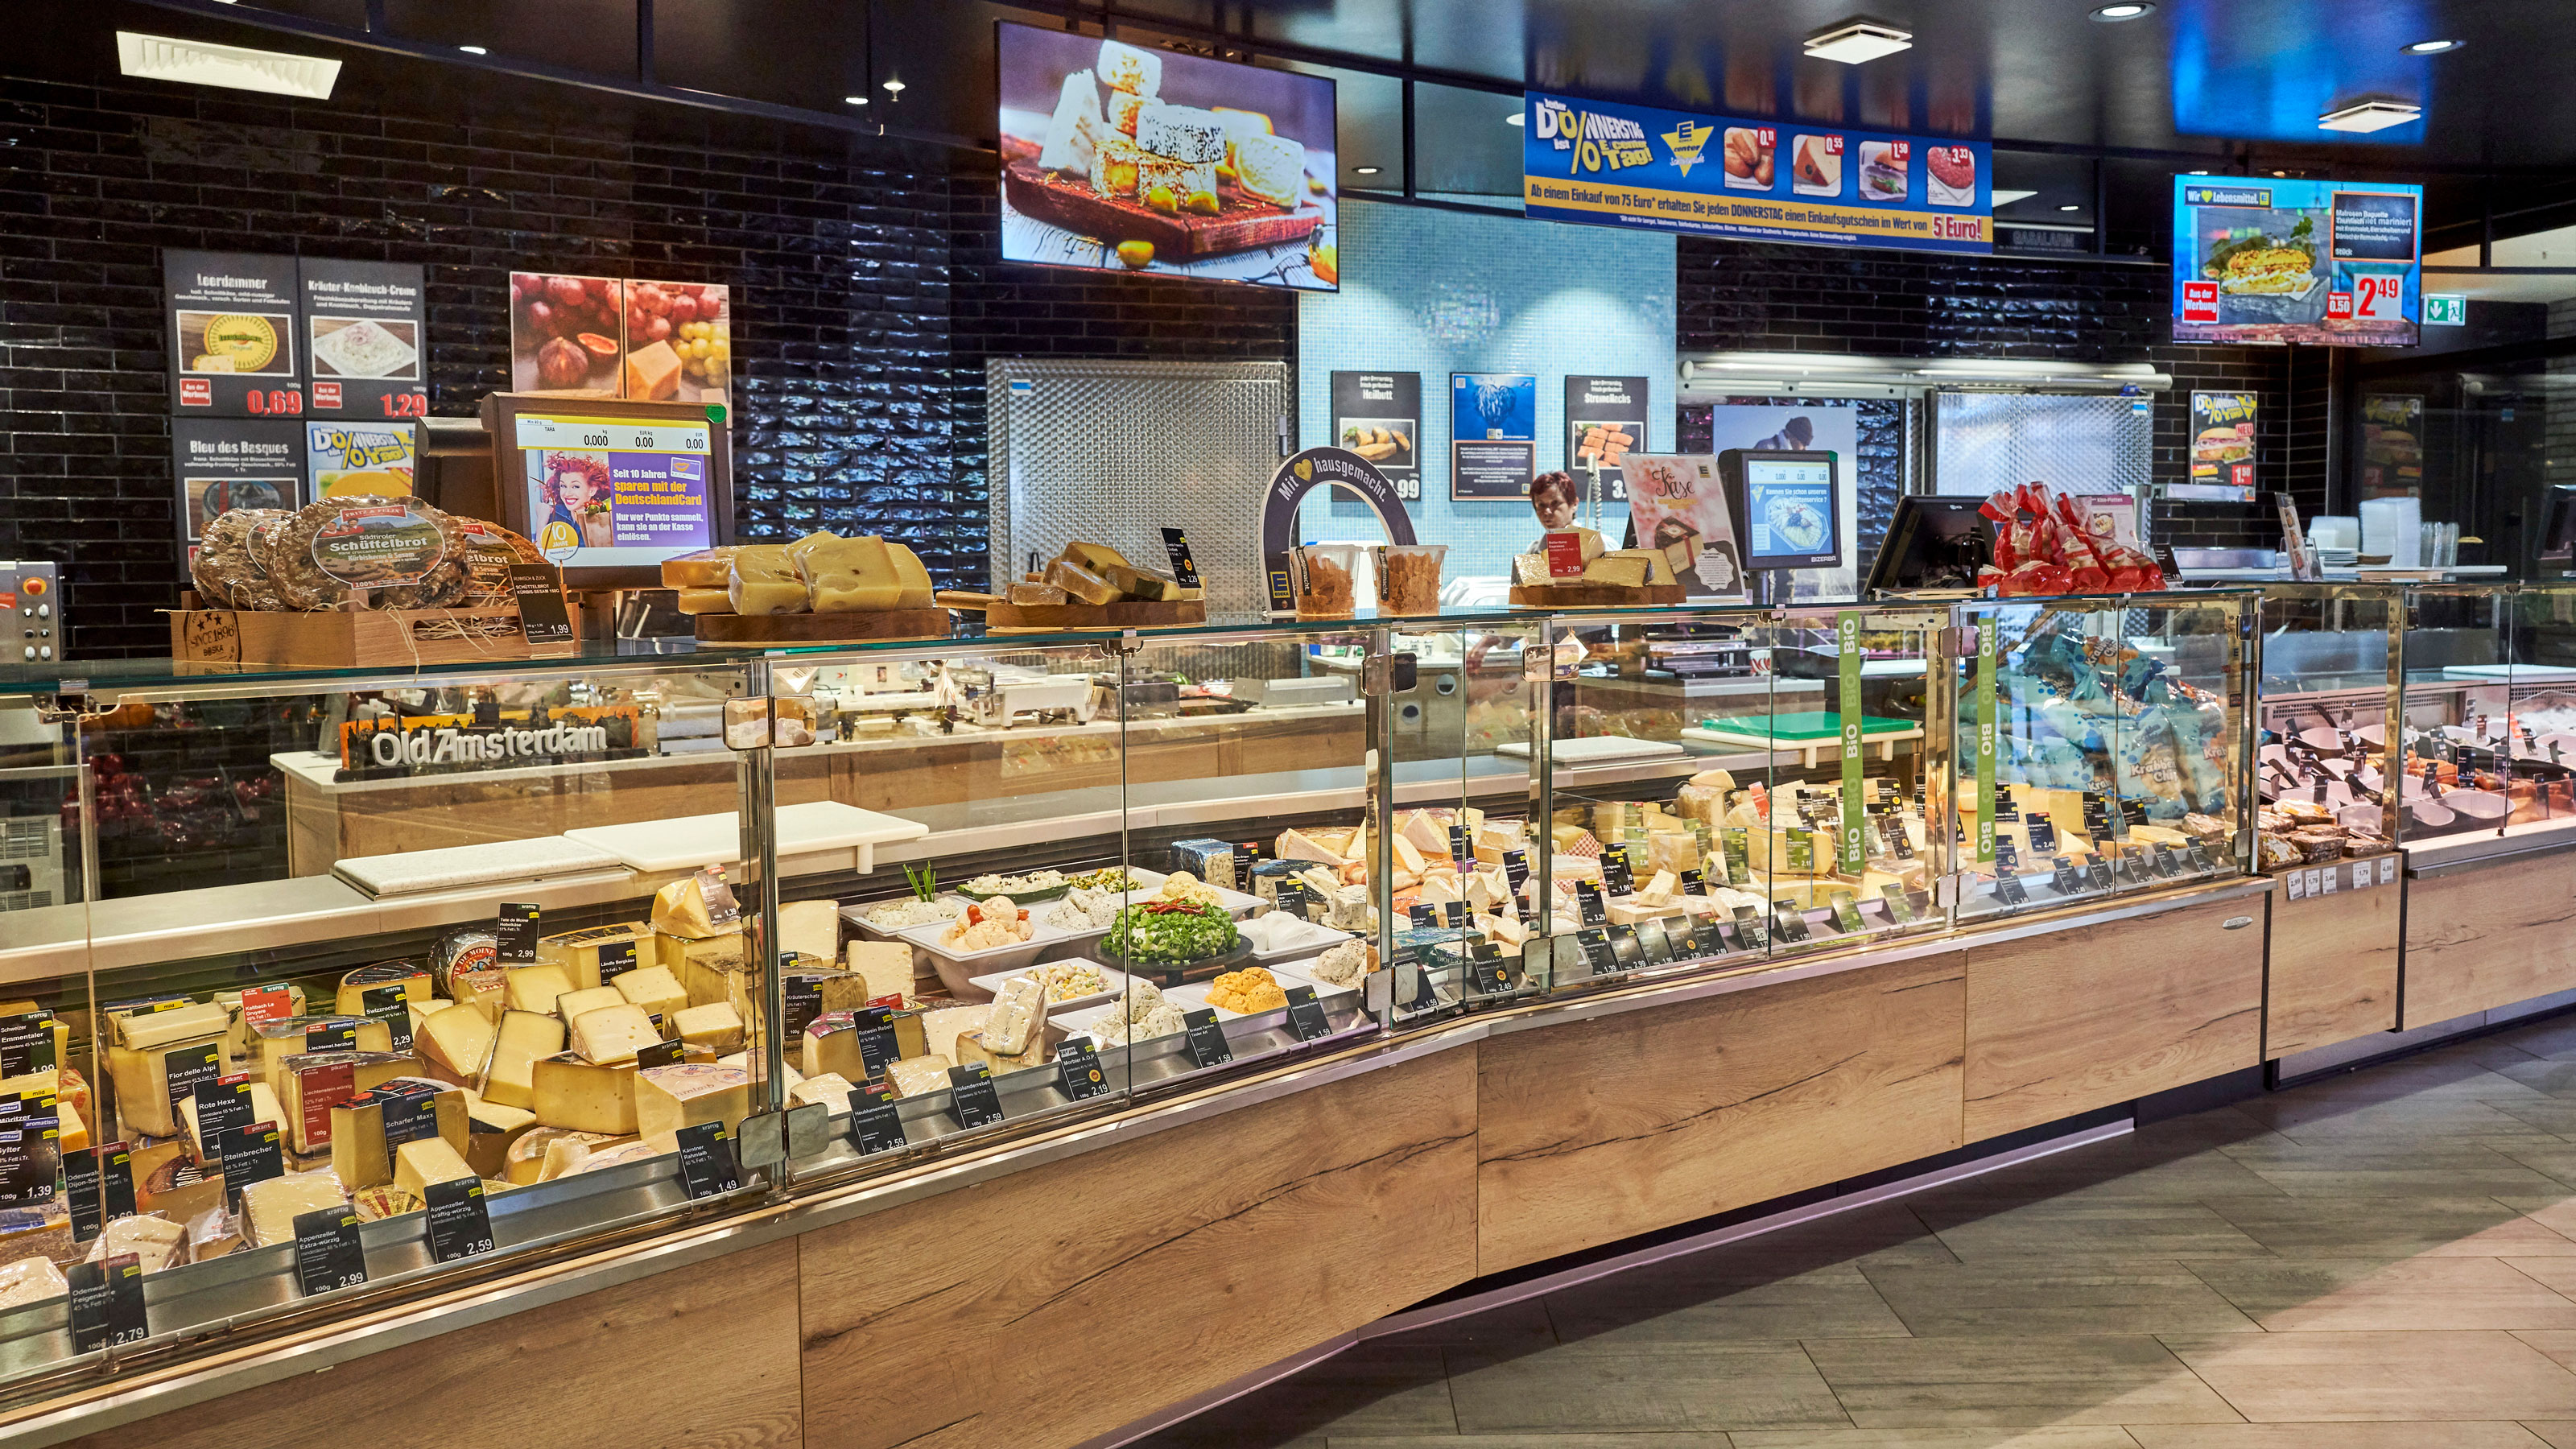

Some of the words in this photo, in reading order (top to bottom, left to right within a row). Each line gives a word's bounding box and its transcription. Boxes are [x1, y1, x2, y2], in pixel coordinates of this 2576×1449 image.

[1554, 138, 1570, 150] ist
[1602, 147, 1653, 170] Tag!
[2187, 190, 2200, 202] Wir
[1531, 184, 1542, 197] Ab
[1544, 187, 1570, 200] einem
[1571, 188, 1602, 204] Einkauf
[1604, 194, 1620, 205] von
[1622, 194, 1632, 206] 75
[1657, 197, 1690, 213] erhalten
[1693, 200, 1704, 213] Sie
[1707, 202, 1729, 217] jeden
[1731, 203, 1783, 221] DONNERSTAG
[1785, 209, 1806, 222] einen
[1808, 211, 1880, 228] Einkaufsgutschein
[1880, 216, 1891, 228] im
[1893, 217, 1911, 229] Wert
[1913, 220, 1927, 231] von
[1933, 215, 1942, 237] 5
[1946, 215, 1982, 239] Euro!
[197, 273, 267, 289] Leerdammer
[308, 280, 416, 296] Kräuter-Knoblauch-Creme
[2189, 289, 2200, 299] Aus
[2202, 290, 2212, 299] der
[2185, 299, 2217, 313] Werbung
[183, 390, 209, 400] Werbung
[315, 394, 341, 402] Werbung
[1363, 389, 1393, 400] Heilbutt
[246, 390, 302, 415] 0,69
[380, 394, 427, 418] 1,29
[2236, 424, 2253, 435] NEU
[190, 440, 215, 454] Bleu
[217, 441, 239, 454] des
[241, 442, 289, 456] Basques
[584, 435, 608, 447] 0,000
[635, 436, 654, 448] 0,00
[686, 438, 704, 450] 0,00
[613, 469, 630, 478] Seit
[630, 469, 640, 479] 10
[641, 470, 667, 479] Jahren
[1278, 475, 1299, 501] Mit
[1314, 457, 1385, 502] hausgemacht.
[614, 481, 650, 492] sparen
[652, 481, 668, 492] mit
[671, 481, 687, 492] der
[1652, 466, 1695, 500] Käse
[615, 493, 702, 506] DeutschlandCard
[616, 513, 629, 522] Nur
[645, 514, 670, 522] Punkte
[671, 514, 704, 522] sammelt,
[551, 525, 566, 540] 10
[617, 523, 634, 531] kann
[671, 523, 694, 531] Kasse
[617, 533, 651, 541] einlösen.
[330, 537, 427, 551] Schüttelbrot
[213, 625, 234, 642] 1896
[551, 624, 569, 635] 1,99
[371, 729, 431, 766] Old
[431, 721, 608, 763] Amsterdam
[458, 955, 469, 965] DE
[469, 947, 496, 956] MOINE
[518, 950, 534, 958] 2,99
[1604, 965, 1616, 973] 1,39
[1498, 982, 1512, 992] 2,49
[246, 1003, 267, 1011] Kaltbach
[1426, 998, 1437, 1007] 1,59
[366, 1005, 400, 1014] Swizzrocker
[1, 1025, 27, 1033] Schweizer
[858, 1028, 877, 1036] Rotwein
[878, 1024, 893, 1033] Rebell
[1319, 1028, 1330, 1038] 1,59
[2, 1032, 43, 1043] Emmentaler
[394, 1034, 411, 1046] 2,29
[1063, 1058, 1081, 1067] Morbier
[1218, 1054, 1231, 1063] 1,59
[202, 1065, 216, 1073] Alpi
[225, 1075, 243, 1084] pikant
[955, 1080, 991, 1092] Holunderrebell
[1092, 1084, 1108, 1096] 2,19
[198, 1102, 216, 1110] Rote
[217, 1098, 235, 1106] Hexe
[855, 1103, 894, 1116] Heublumenrebell
[26, 1119, 58, 1127] aromatisch
[386, 1117, 414, 1128] Scharfer
[417, 1113, 433, 1121] Maxx
[986, 1113, 1002, 1124] 2,59
[251, 1123, 270, 1132] pikant
[683, 1145, 704, 1154] Kärntner
[887, 1137, 904, 1150] 2,59
[224, 1146, 273, 1162] Steinbrecher
[684, 1150, 708, 1159] Rahmlaib
[27, 1185, 52, 1198] 1,39
[718, 1179, 737, 1192] 1,49
[327, 1207, 349, 1216] kräftig
[430, 1200, 464, 1212] Appenzeller
[431, 1206, 471, 1219] kräftig-würzig
[299, 1230, 336, 1243] Appenzeller
[299, 1236, 340, 1249] Extra-würzig
[467, 1239, 492, 1254] 2,59
[340, 1272, 363, 1287] 2,99
[117, 1327, 144, 1344] 2,79
